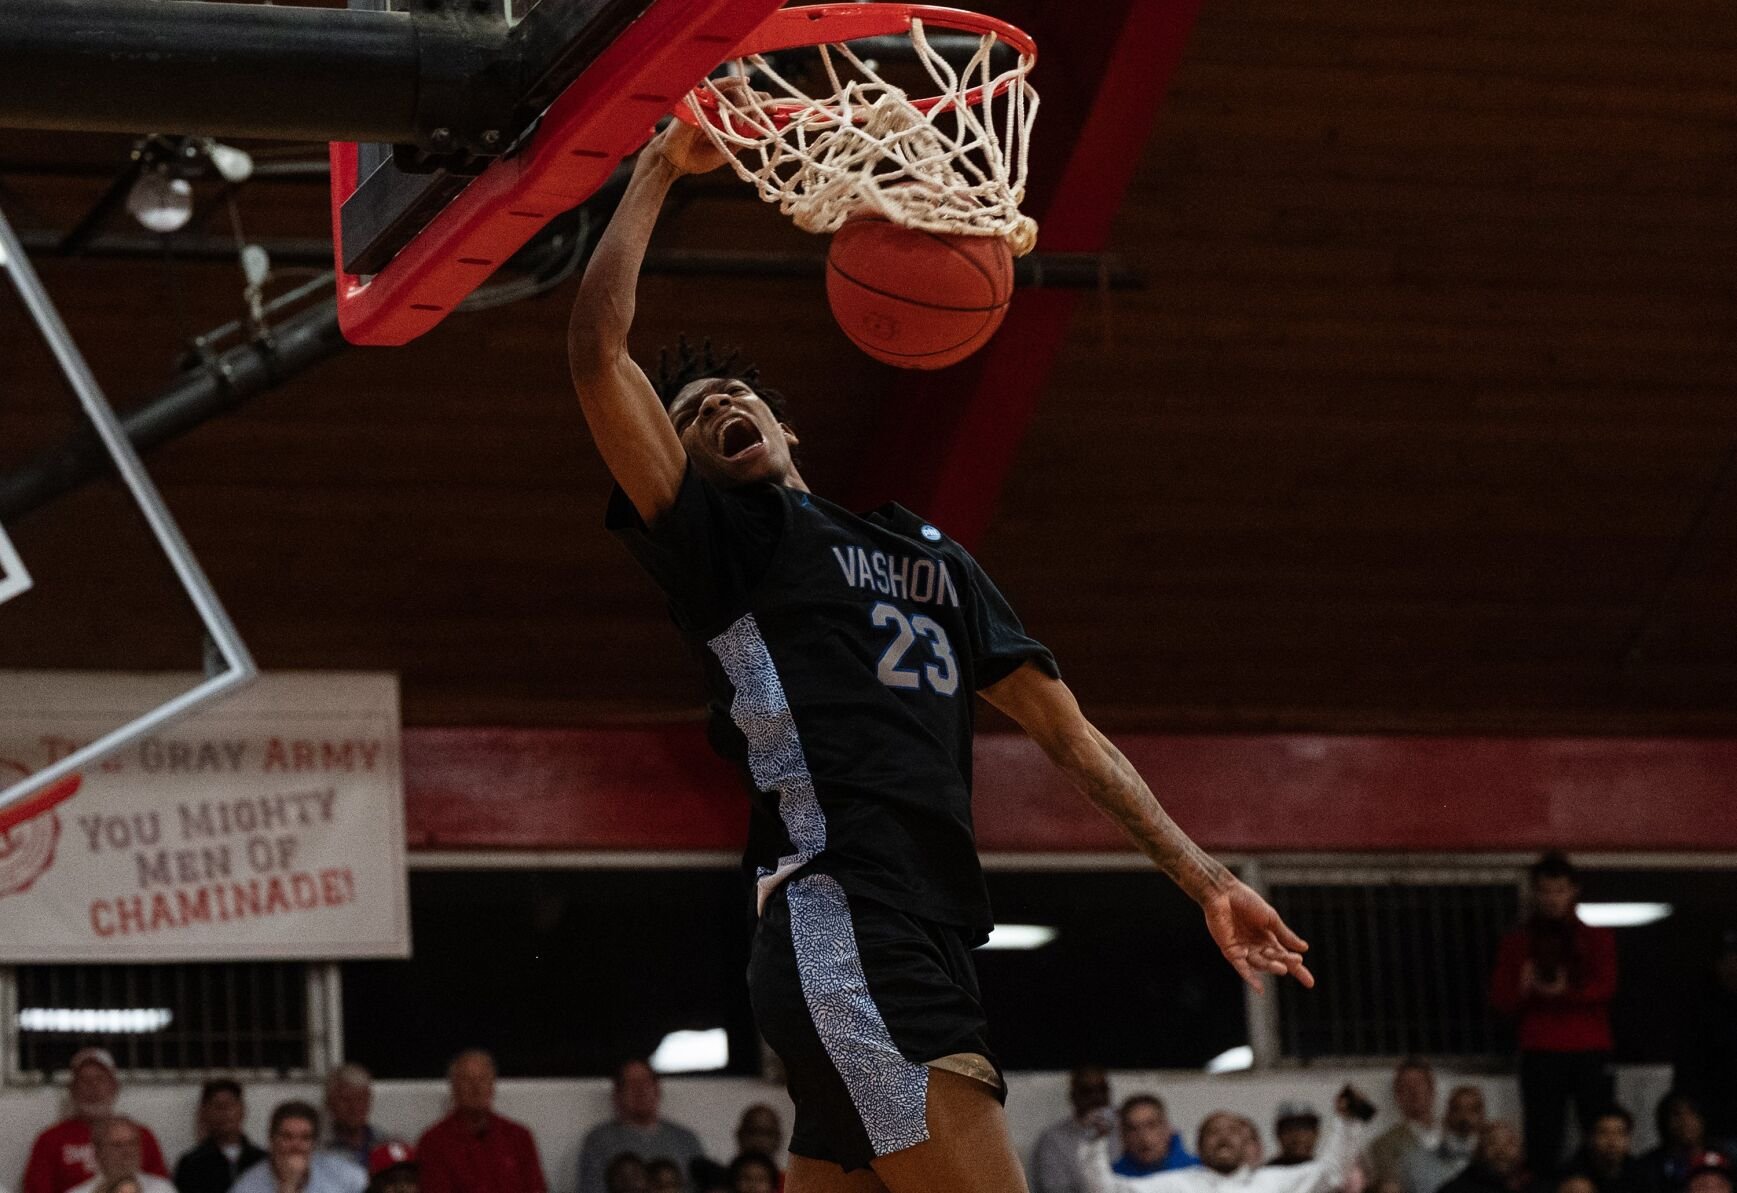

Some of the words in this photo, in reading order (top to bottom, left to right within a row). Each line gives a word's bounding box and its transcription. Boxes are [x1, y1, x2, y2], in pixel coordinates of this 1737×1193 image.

[831, 546, 960, 608] VASHON
[870, 600, 960, 697] 23
[138, 738, 248, 773] GRAY
[263, 736, 381, 773] ARMY
[78, 812, 160, 853] YOU
[177, 787, 336, 840] MIGHTY
[135, 845, 232, 888] MEN
[247, 837, 297, 873] OF
[89, 866, 355, 938] CHAMINADE!
